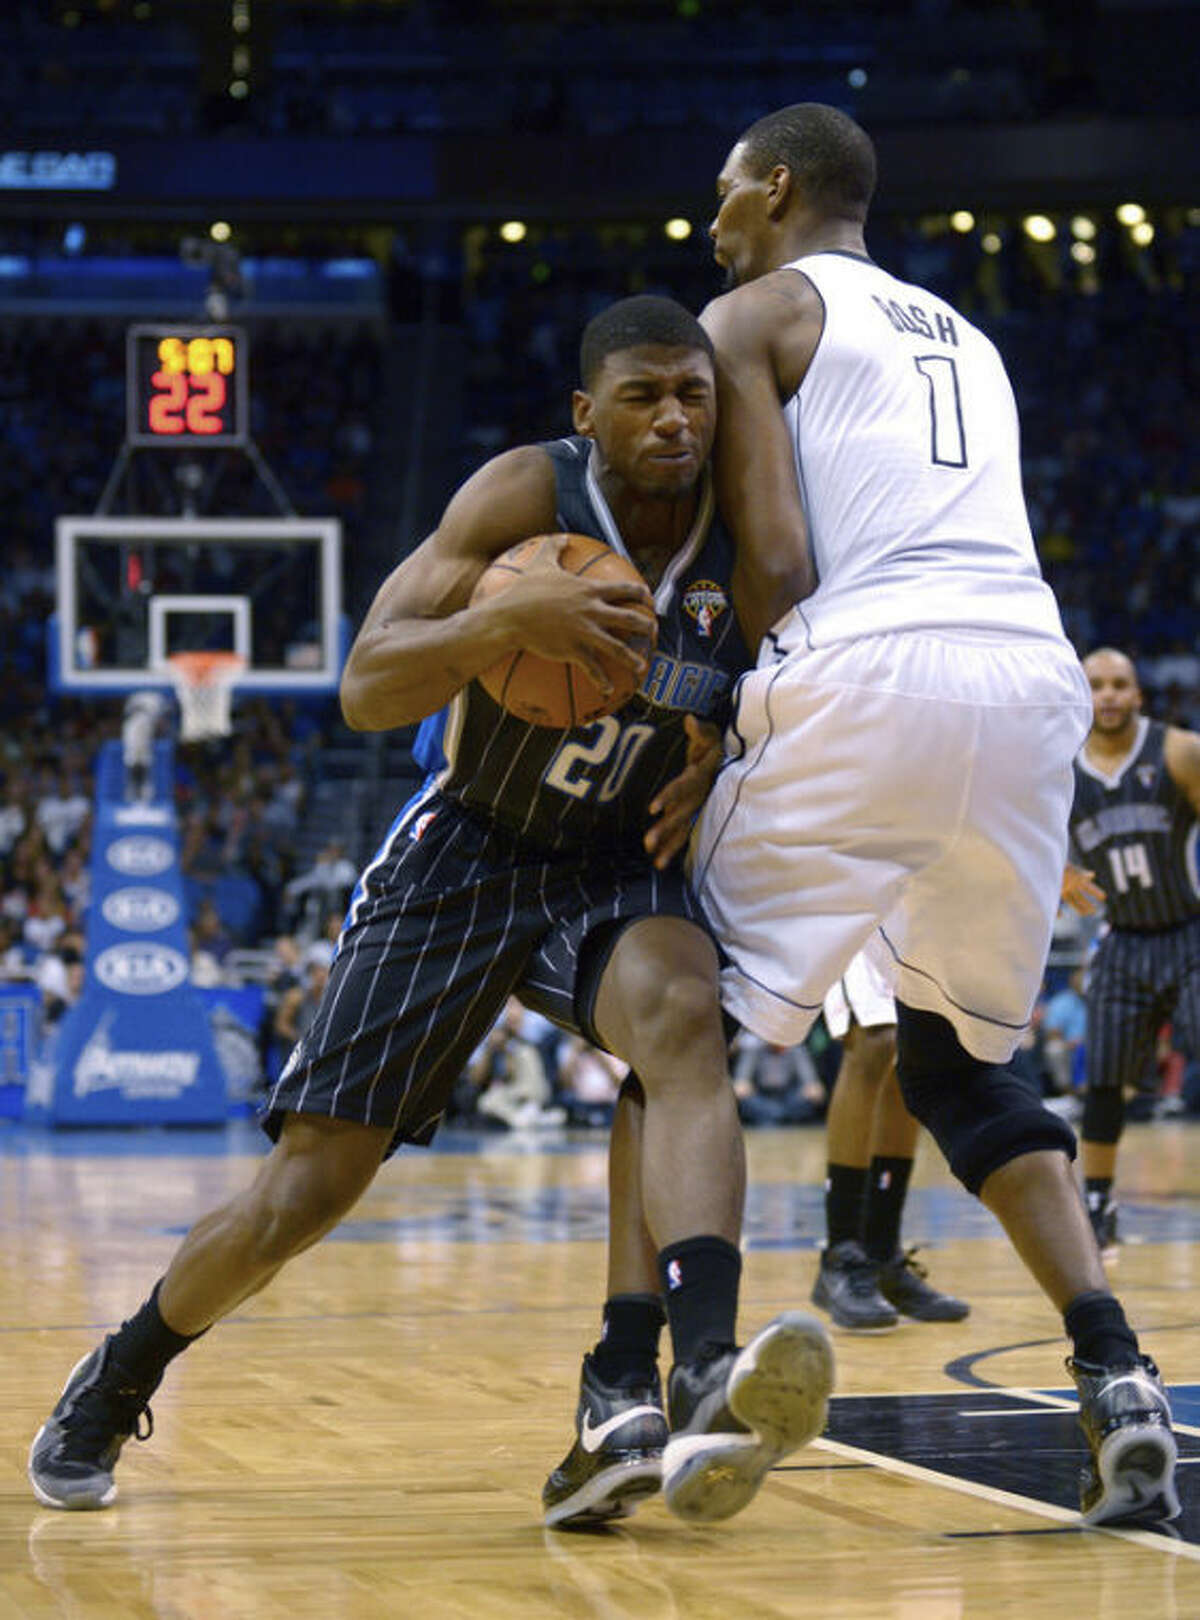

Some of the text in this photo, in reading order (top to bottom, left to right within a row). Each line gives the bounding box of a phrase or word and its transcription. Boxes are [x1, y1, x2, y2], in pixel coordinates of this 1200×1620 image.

[871, 294, 959, 347] BOSH
[149, 369, 226, 434] 22
[912, 354, 968, 468] 1
[640, 652, 730, 716] AGIC
[545, 714, 655, 802] 20
[1108, 843, 1153, 893] 14
